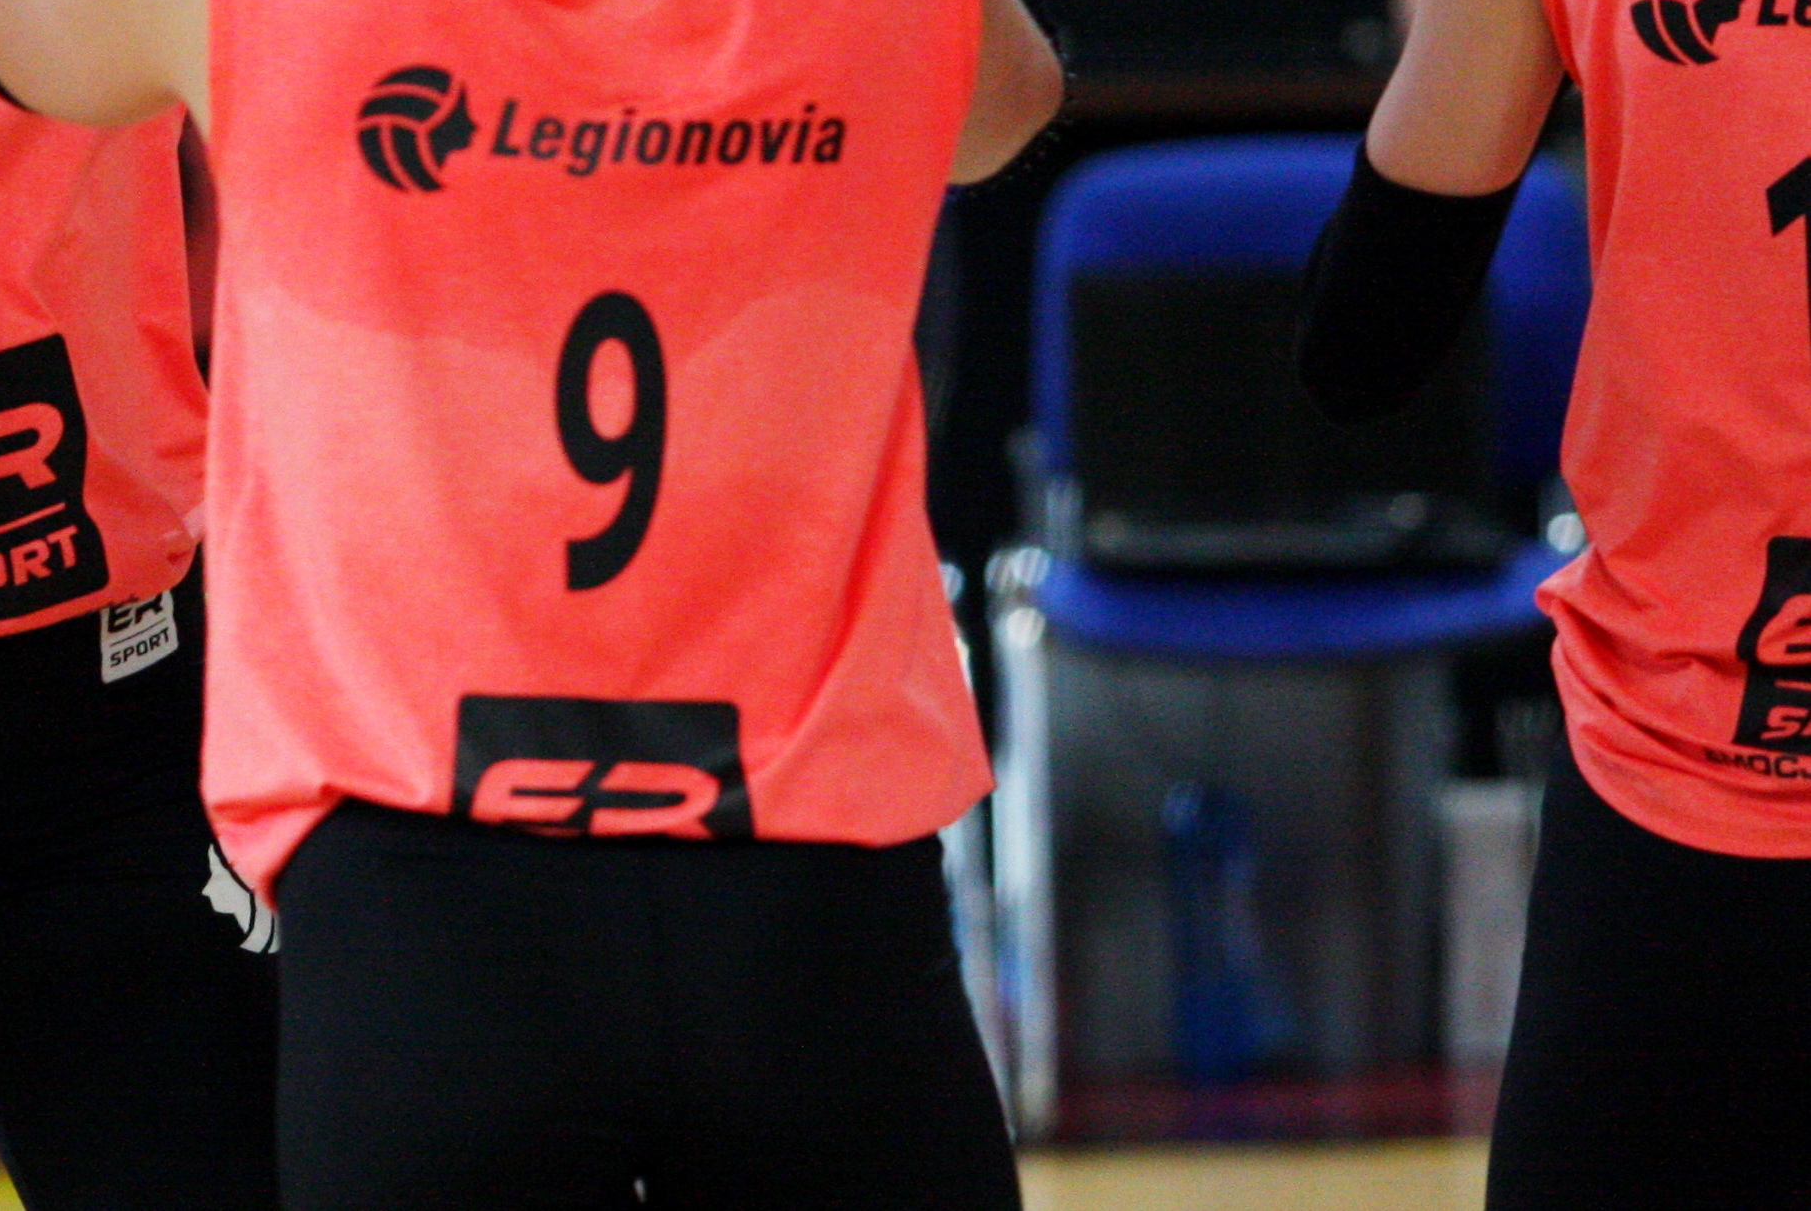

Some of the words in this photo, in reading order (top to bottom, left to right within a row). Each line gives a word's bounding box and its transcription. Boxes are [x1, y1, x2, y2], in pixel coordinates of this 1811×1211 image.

[491, 99, 846, 177] Legionovia
[556, 292, 667, 591] 9
[110, 627, 170, 668] SPORT
[469, 757, 720, 838] ER
